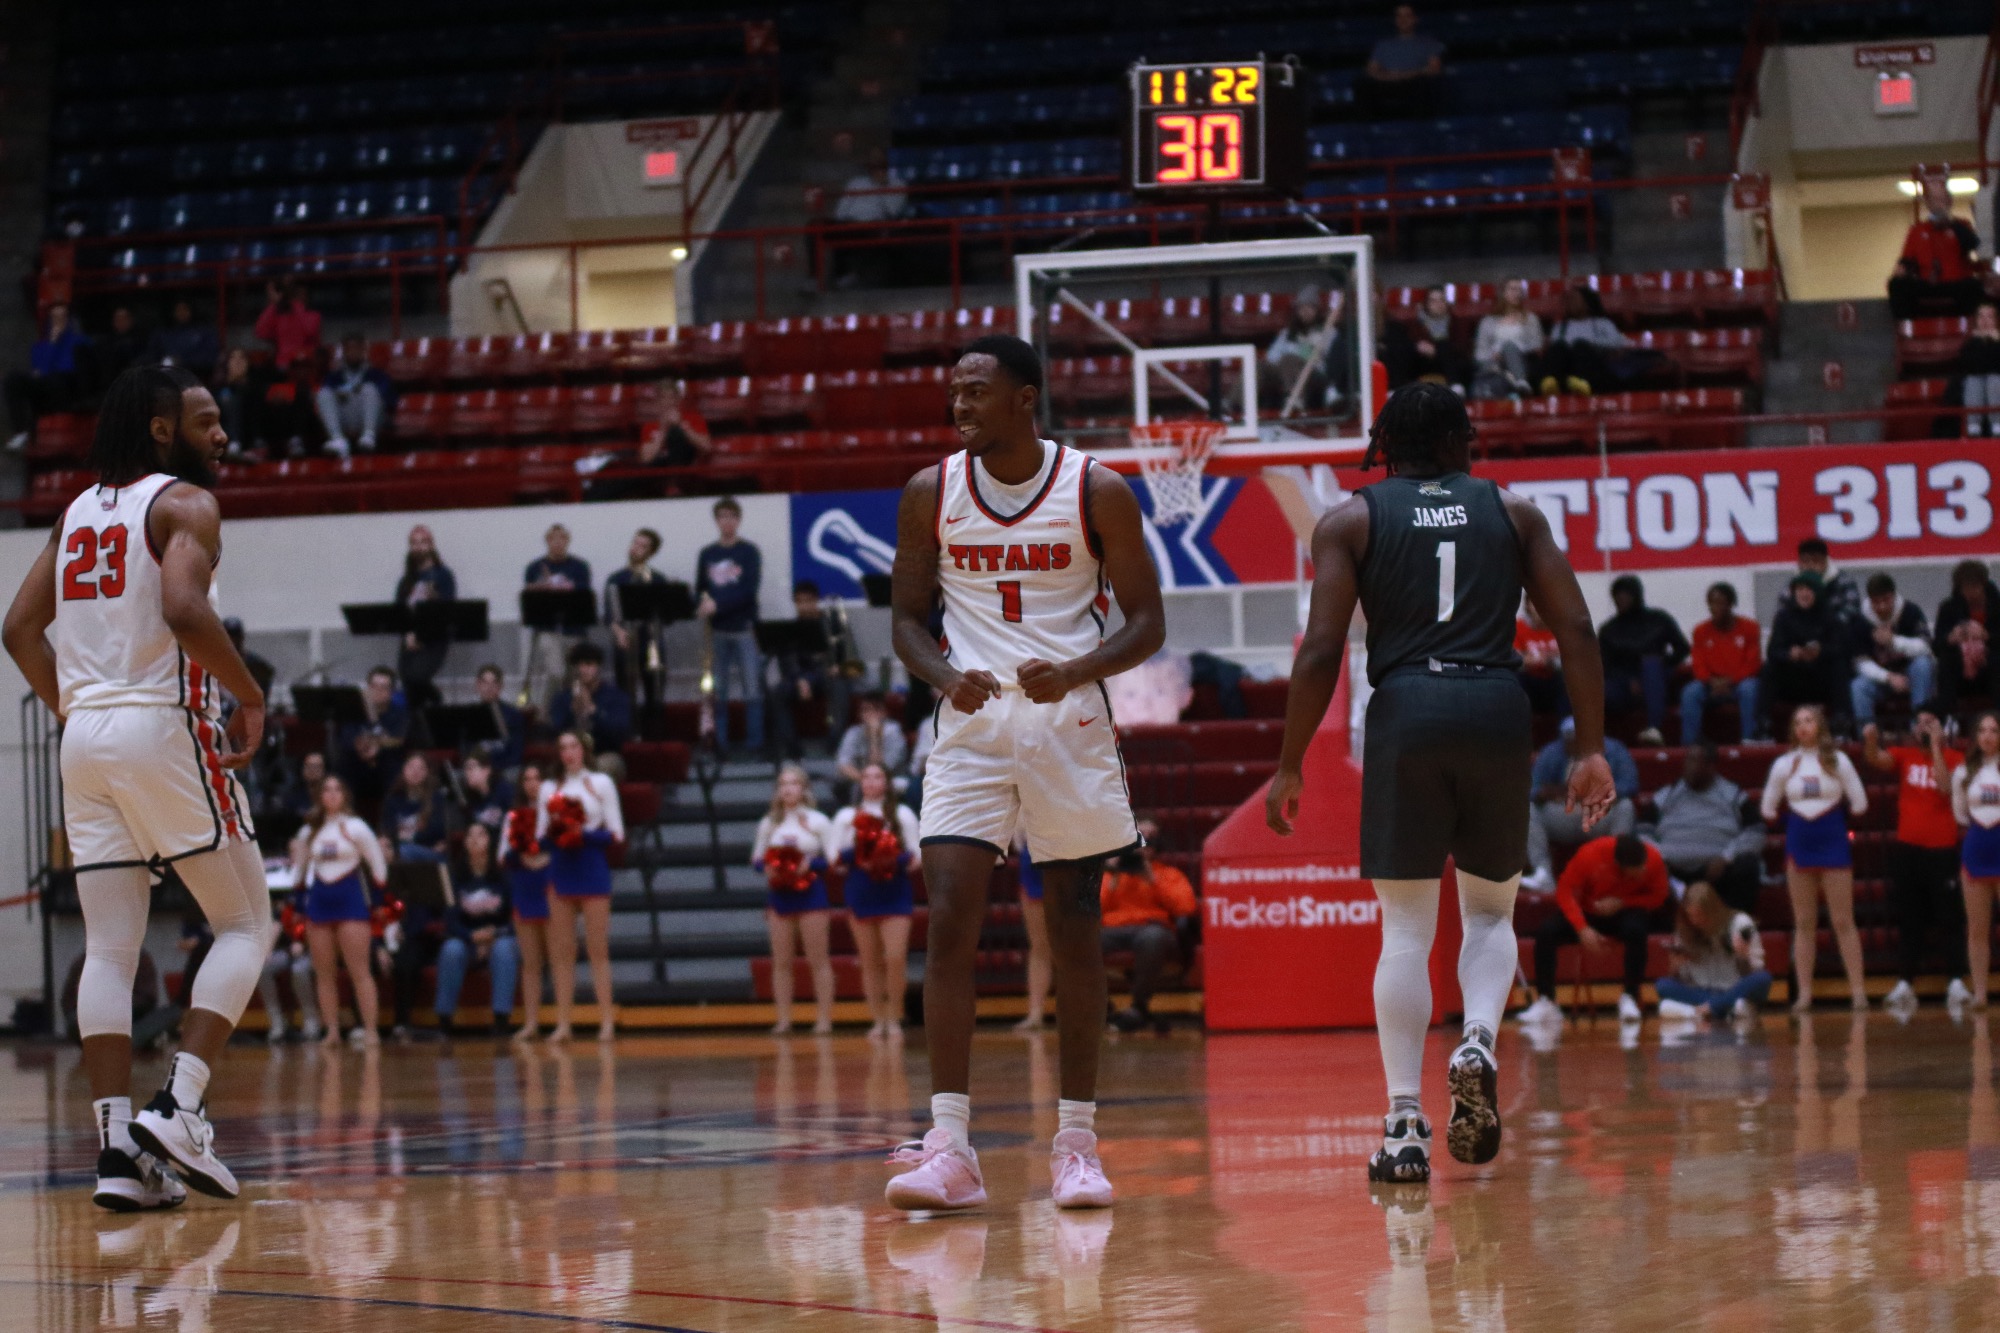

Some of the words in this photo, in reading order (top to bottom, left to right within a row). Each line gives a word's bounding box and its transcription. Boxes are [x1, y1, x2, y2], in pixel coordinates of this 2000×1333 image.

[1156, 113, 1241, 183] 30
[1412, 505, 1468, 527] JAMES
[1814, 460, 1994, 544] 313
[63, 522, 128, 601] 23
[948, 543, 1072, 571] TITANS
[1436, 541, 1456, 622] 1
[996, 581, 1022, 623] 1
[1206, 896, 1382, 927] TicketSmar
